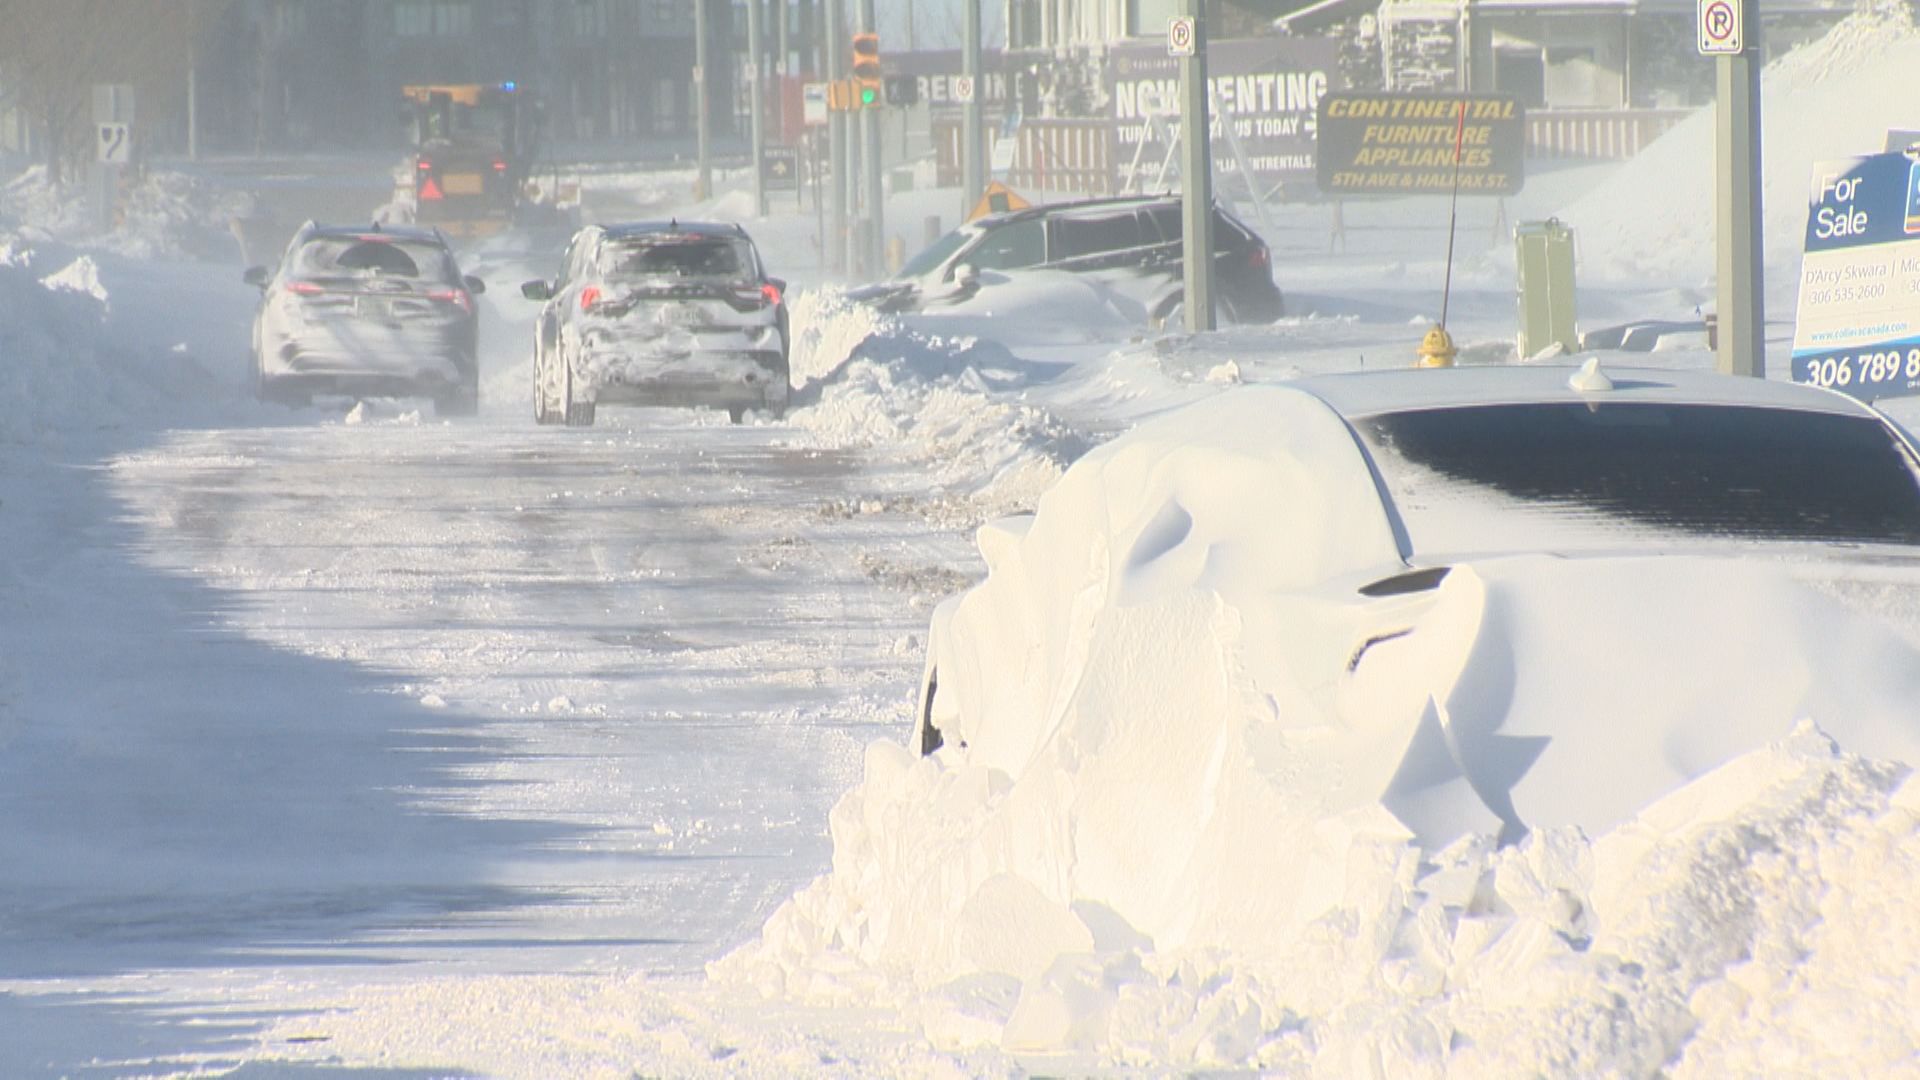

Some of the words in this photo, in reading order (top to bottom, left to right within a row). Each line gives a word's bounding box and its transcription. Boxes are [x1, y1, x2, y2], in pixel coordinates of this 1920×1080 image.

[1328, 98, 1514, 118] CONTINENTAL
[1256, 115, 1299, 138] TODAY
[1364, 124, 1491, 144] FURNITURE
[1354, 147, 1492, 166] APPLIANCES
[1331, 172, 1364, 187] 5TH
[1367, 173, 1398, 187] AVE
[1400, 173, 1412, 187] &
[1819, 172, 1863, 204] For
[1815, 204, 1868, 239] Sale
[1805, 268, 1842, 285] D'Arcy
[1844, 263, 1887, 280] Skwara
[1810, 288, 1831, 305] 306
[1834, 286, 1854, 303] 535
[1857, 282, 1886, 301] 2600
[1806, 355, 1852, 388] 306
[1857, 350, 1902, 385] 789
[1905, 348, 1920, 379] 8
